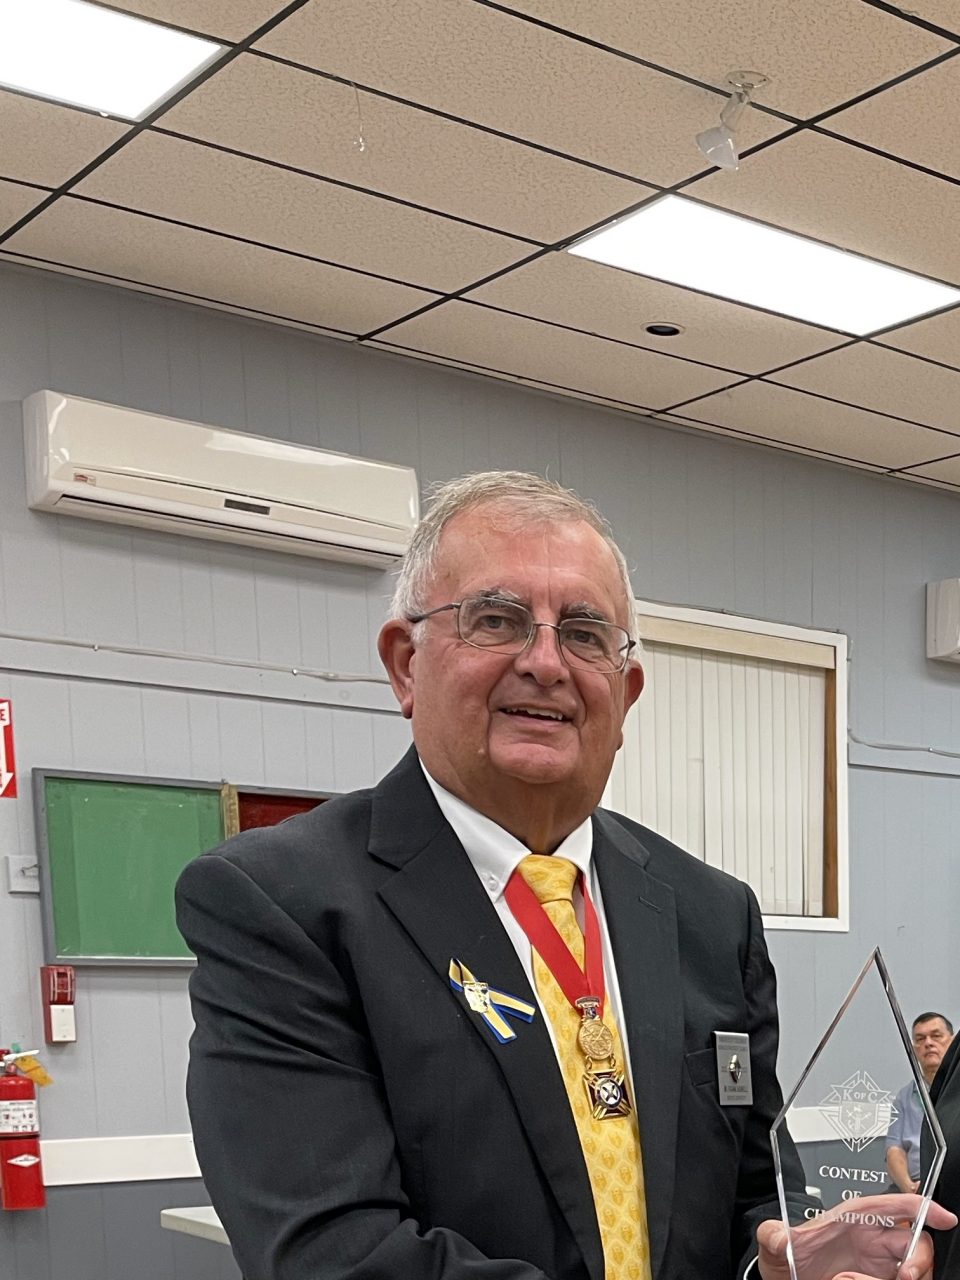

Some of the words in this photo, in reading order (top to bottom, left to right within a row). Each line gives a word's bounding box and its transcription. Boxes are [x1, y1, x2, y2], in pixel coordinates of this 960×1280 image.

[843, 1089, 852, 1100] K
[854, 1092, 866, 1100] OF
[868, 1091, 878, 1103] C
[819, 1165, 888, 1184] CONTEST
[841, 1189, 863, 1201] OF
[804, 1207, 895, 1228] CHMPIONS
